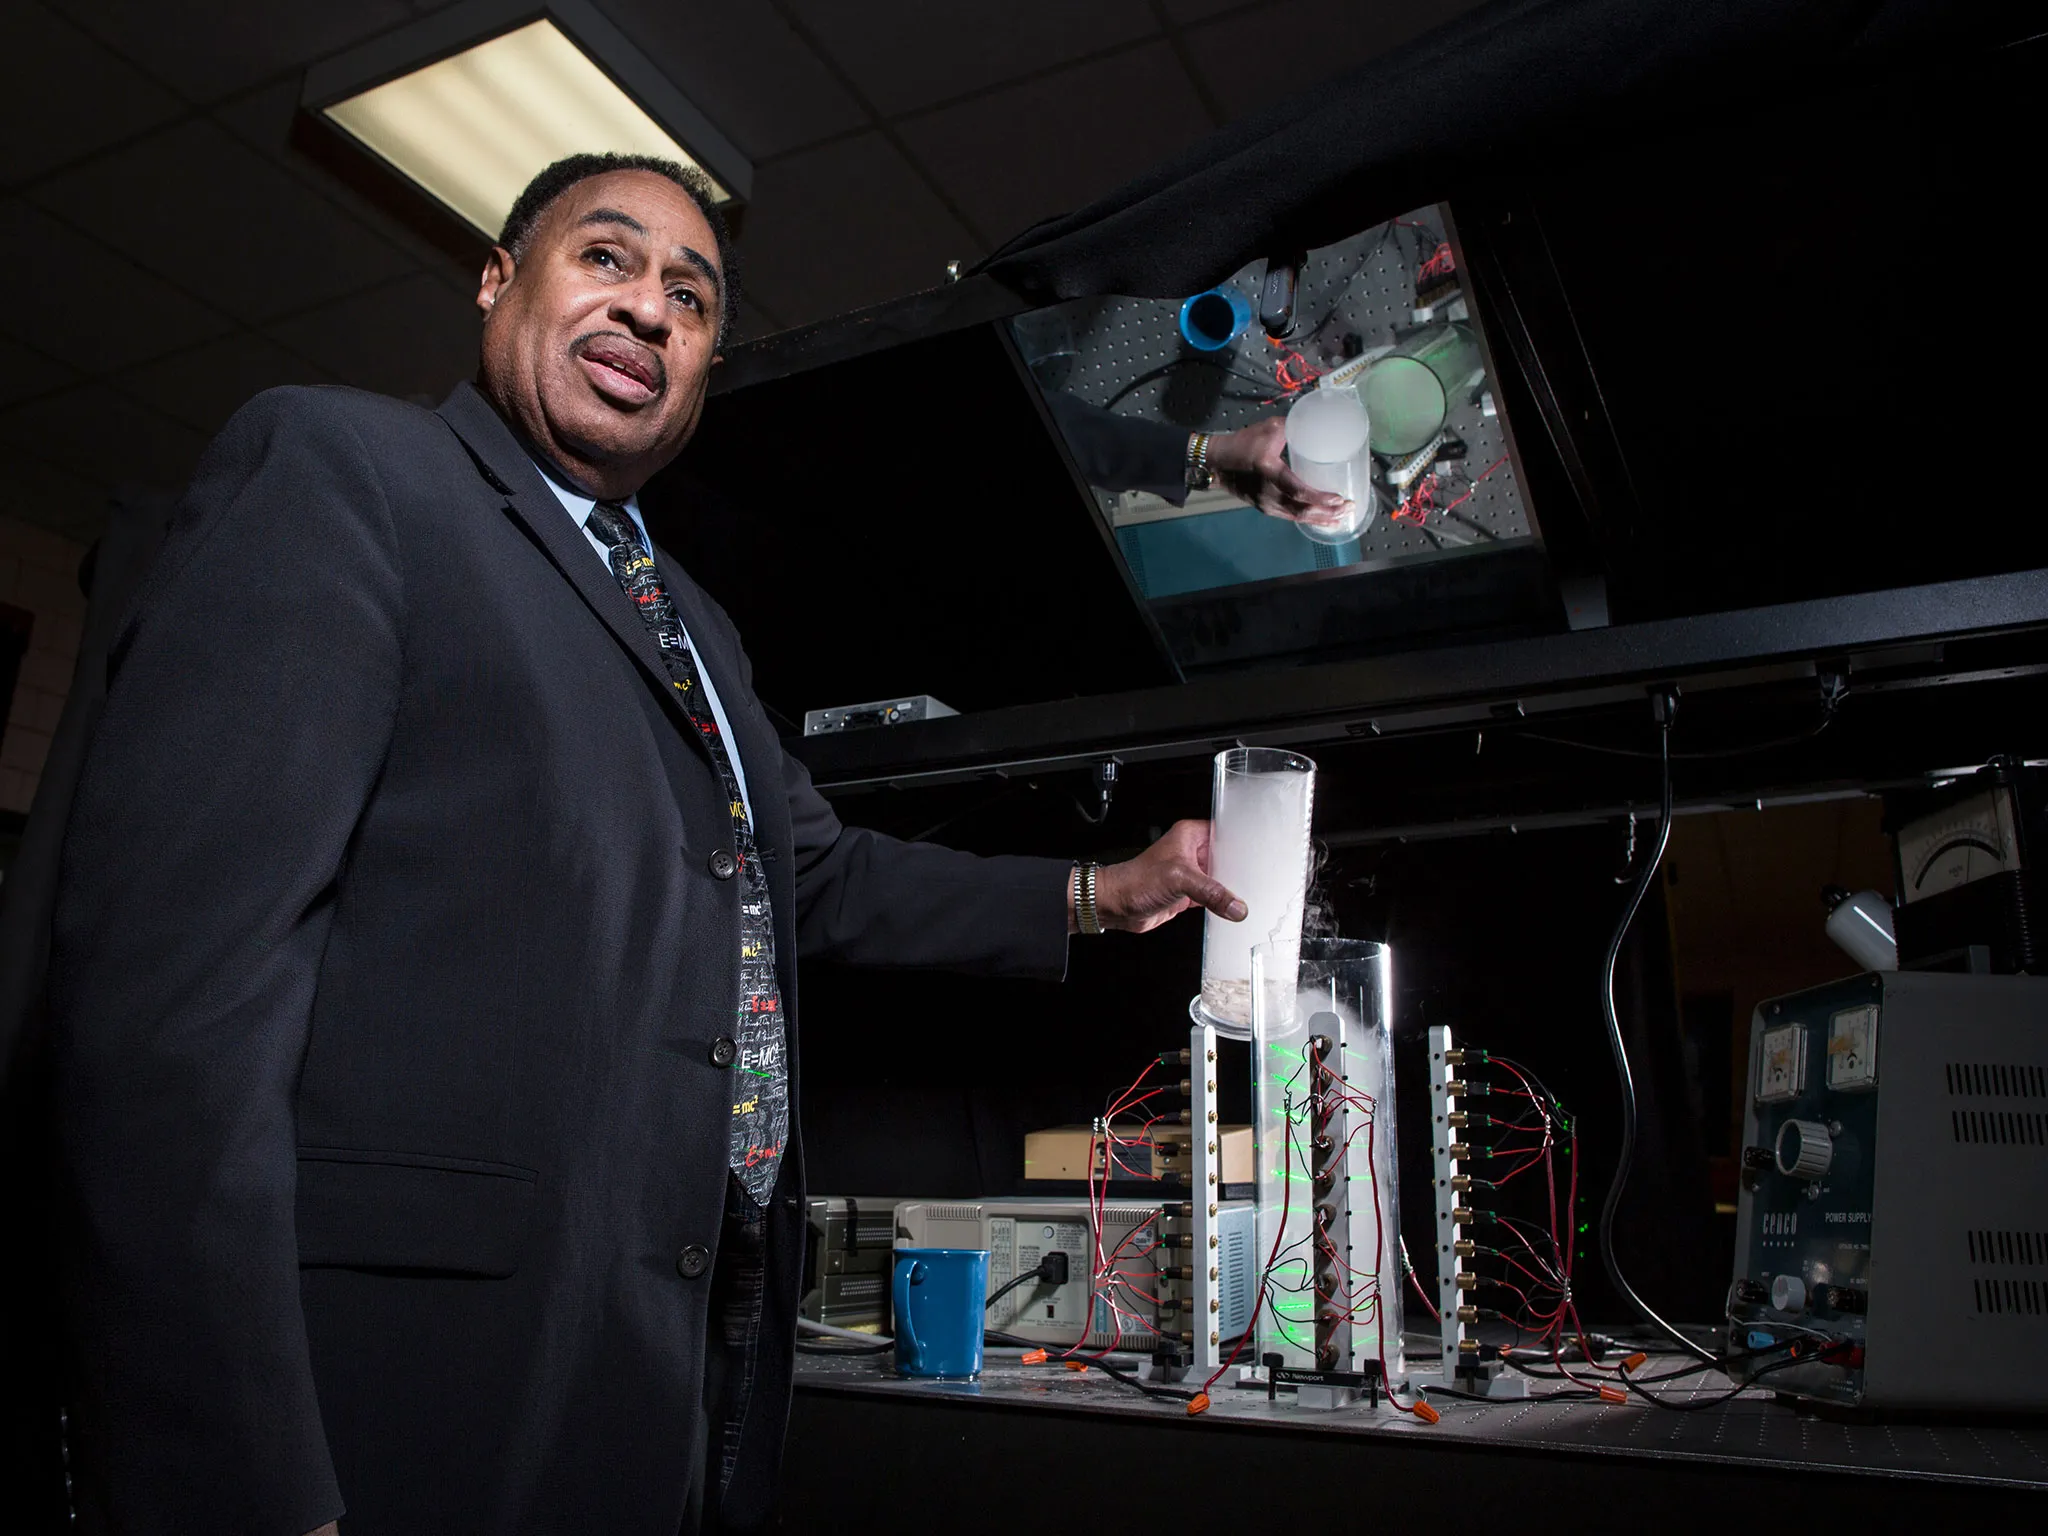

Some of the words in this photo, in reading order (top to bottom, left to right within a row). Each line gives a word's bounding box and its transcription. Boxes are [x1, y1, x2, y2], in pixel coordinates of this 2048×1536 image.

[1825, 1211, 1847, 1224] POWER
[1847, 1211, 1872, 1224] SUPPLY
[1291, 1373, 1325, 1382] Newport
